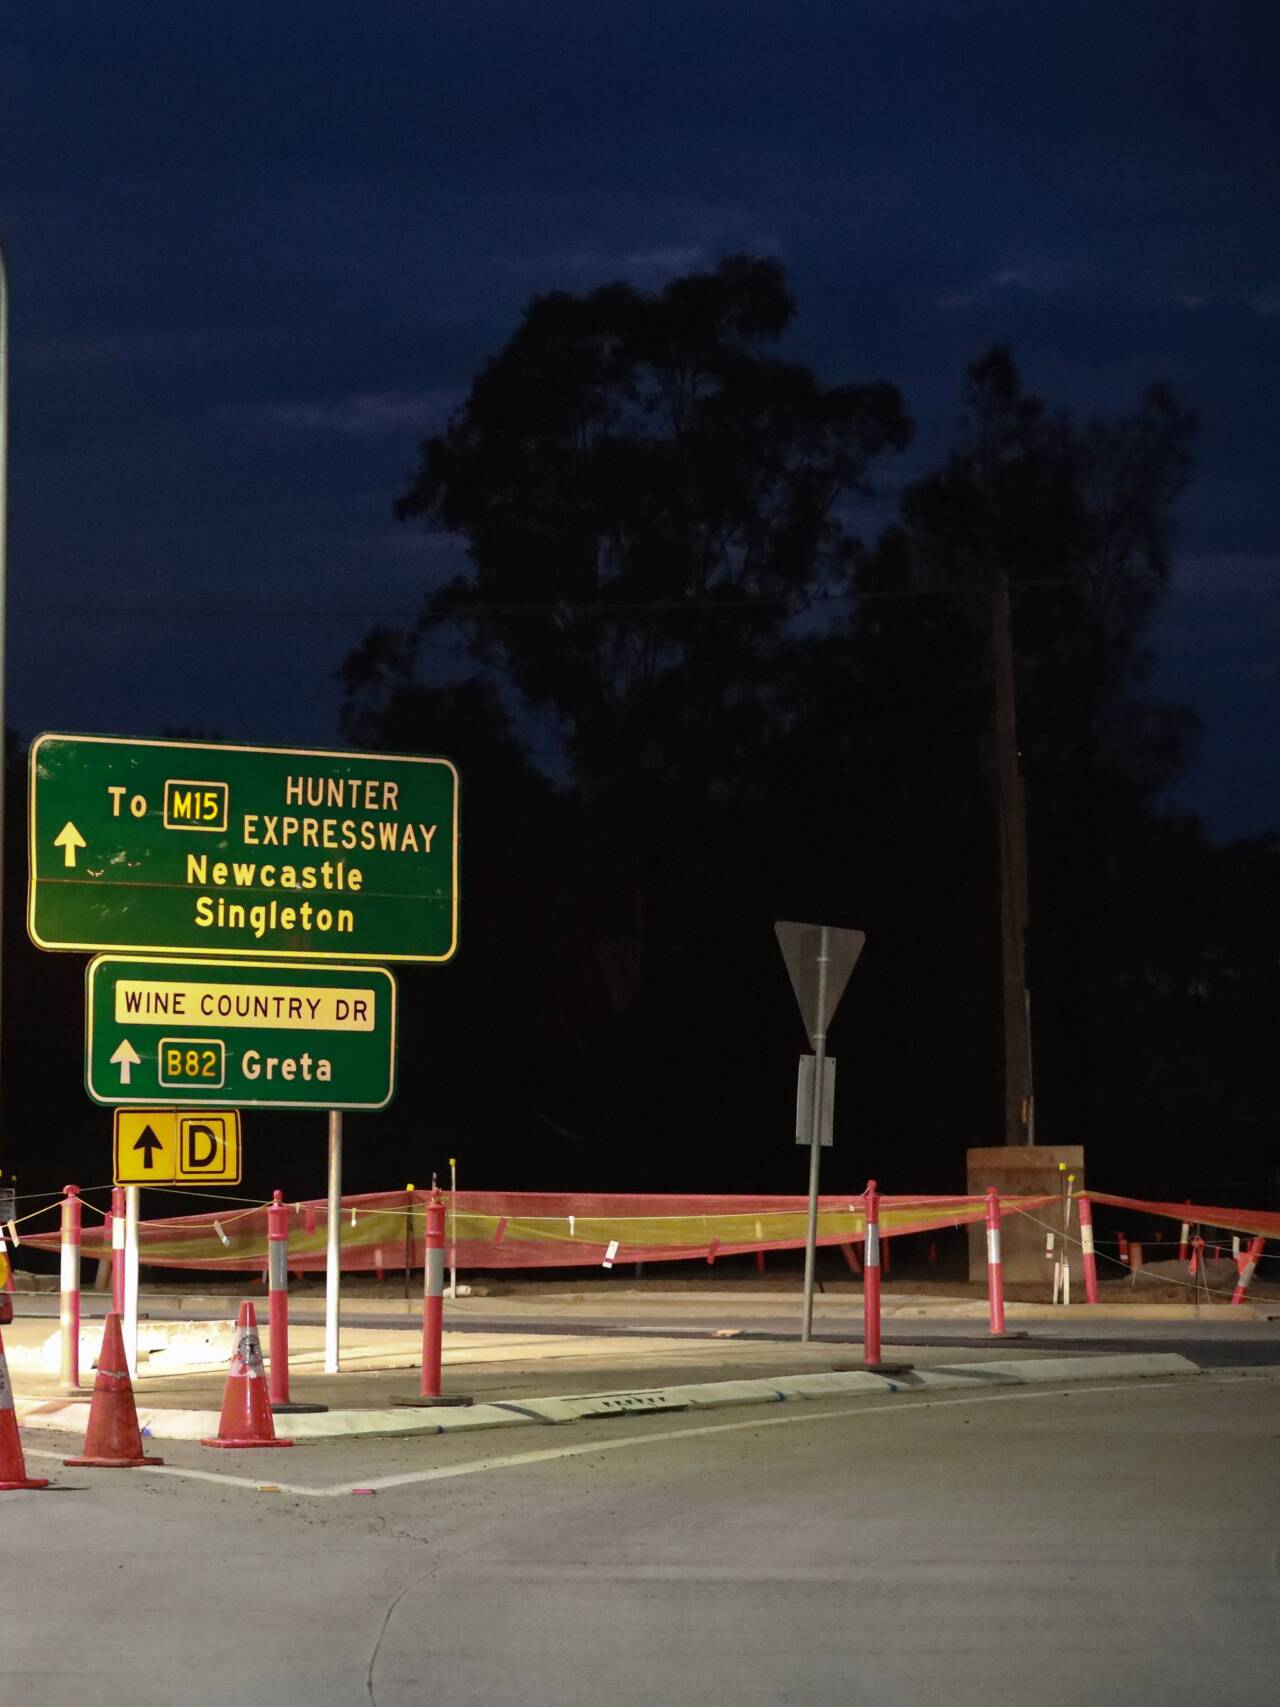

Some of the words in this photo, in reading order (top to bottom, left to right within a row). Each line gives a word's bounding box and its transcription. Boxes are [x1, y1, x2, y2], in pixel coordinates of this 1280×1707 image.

[108, 786, 147, 818] To
[173, 791, 218, 820] M15
[286, 776, 399, 811] HUNTER
[244, 815, 437, 853] EXPRESSWAY
[187, 854, 363, 891] Newcastle
[194, 896, 354, 938] Singleton
[125, 991, 186, 1015] WINE
[200, 994, 321, 1019] COUNTRY
[335, 999, 368, 1022] DR
[167, 1050, 216, 1077] B82
[241, 1050, 332, 1082] Greta
[188, 1124, 218, 1168] D
